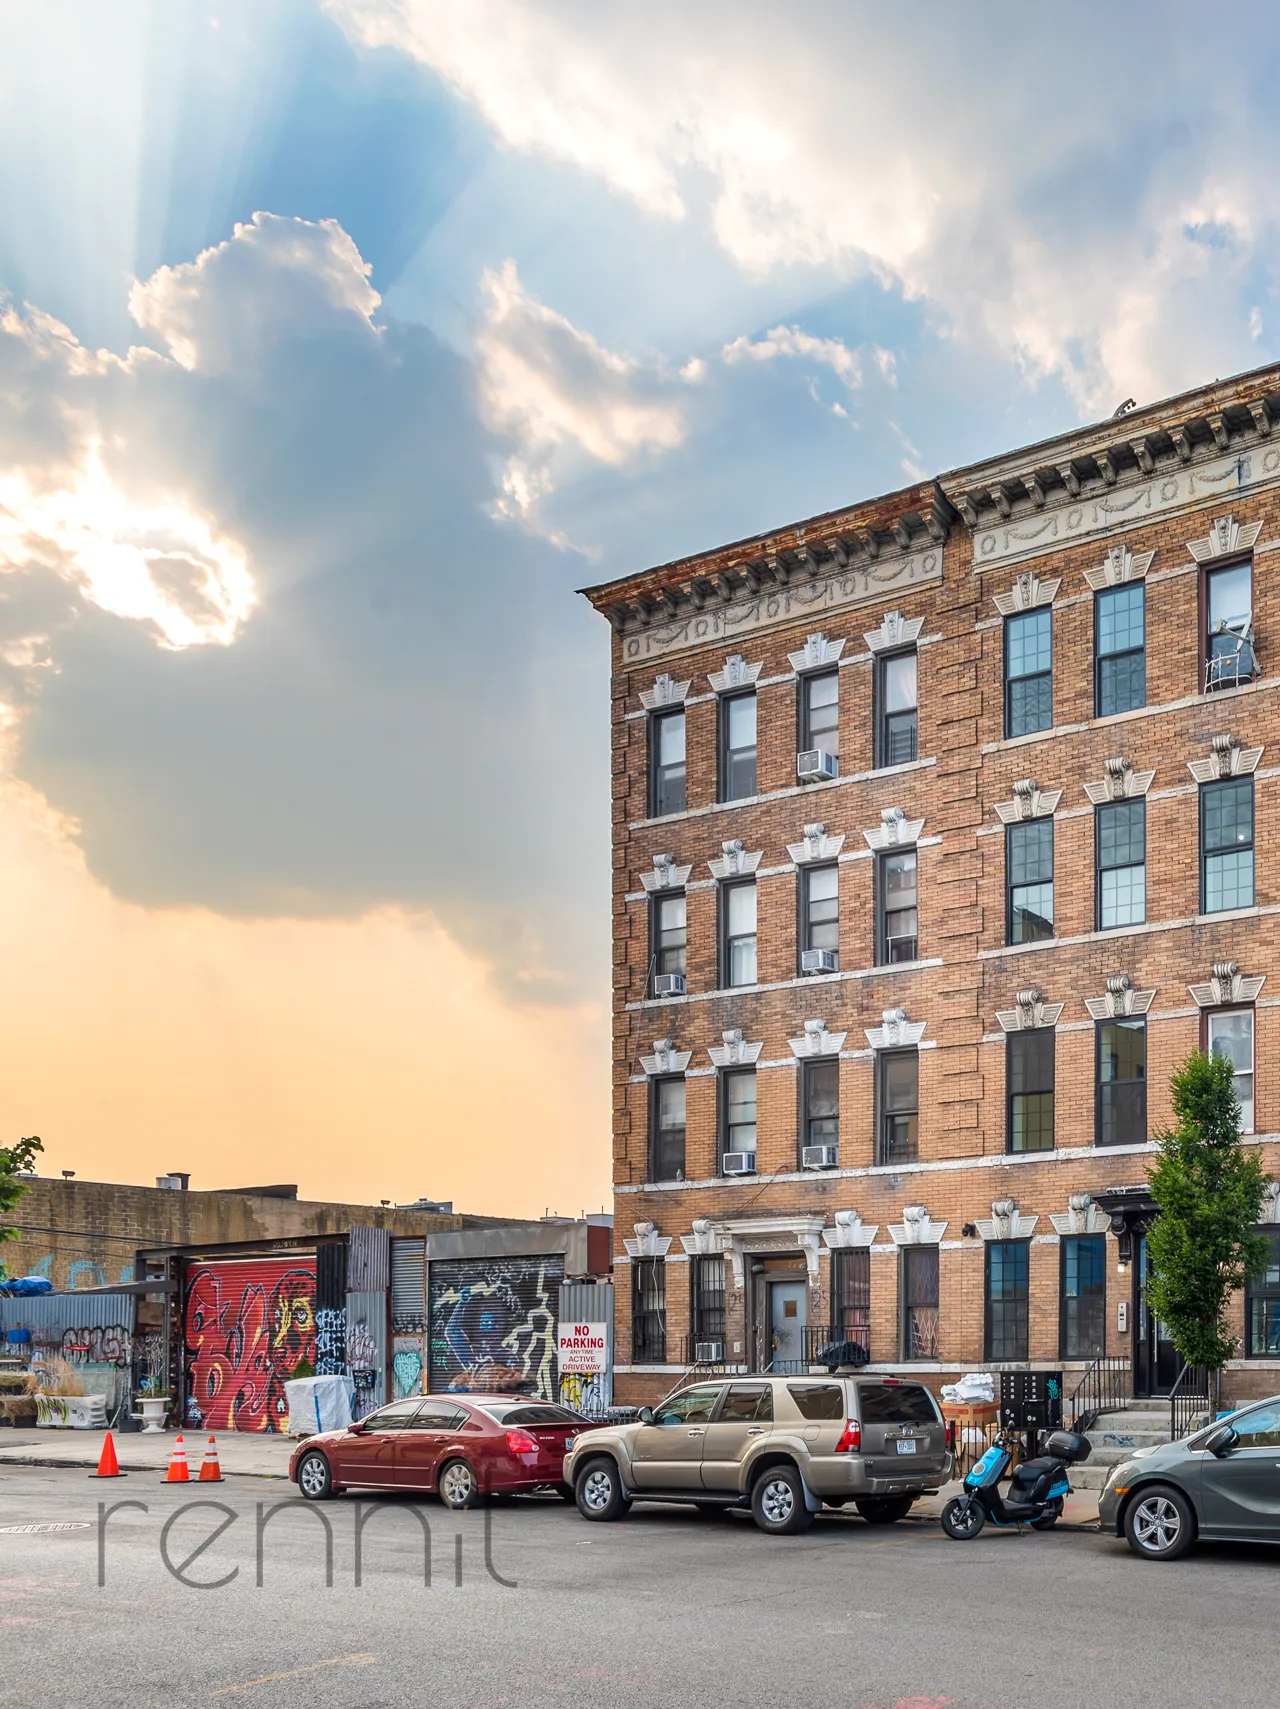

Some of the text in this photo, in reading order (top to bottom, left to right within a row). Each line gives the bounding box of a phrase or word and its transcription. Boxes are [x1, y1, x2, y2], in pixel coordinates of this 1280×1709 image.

[574, 1325, 590, 1336] NO
[560, 1337, 604, 1349] PARKING
[568, 1355, 596, 1363] ACTIVE
